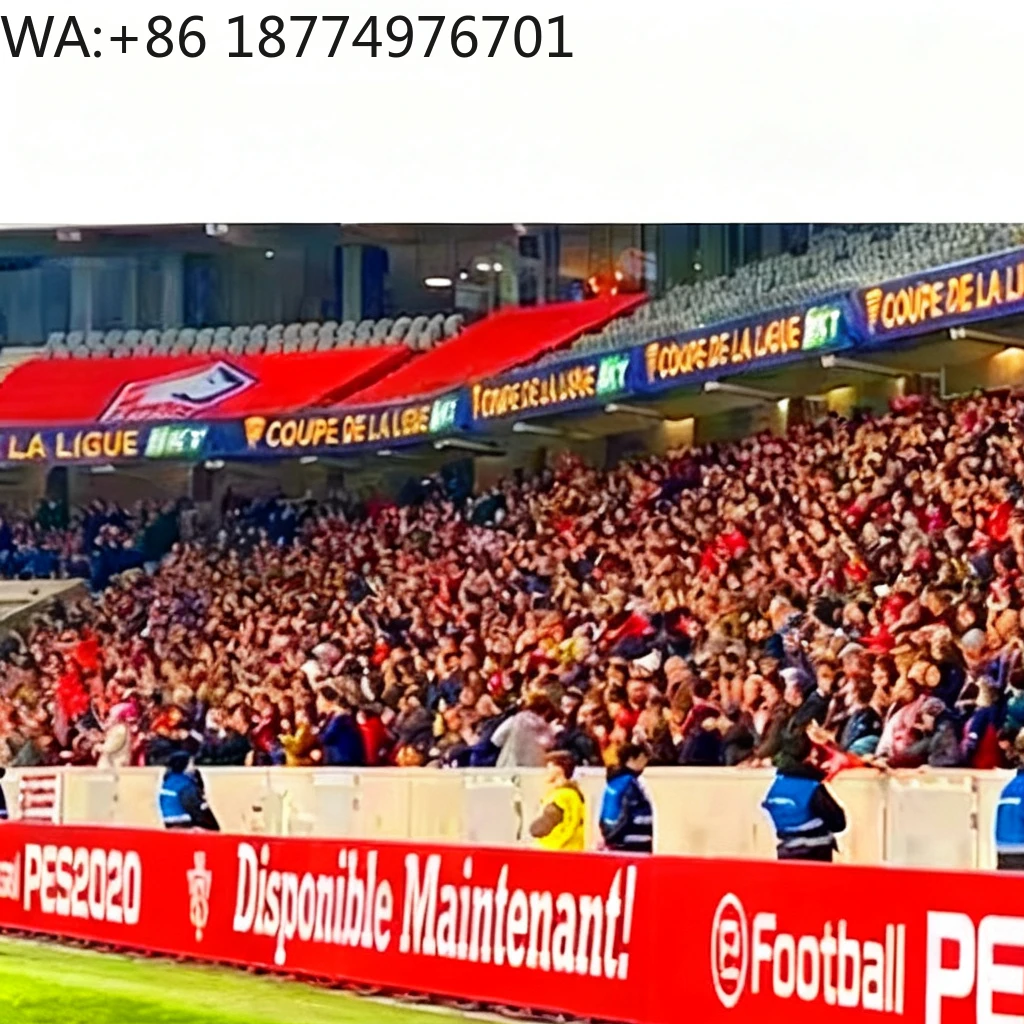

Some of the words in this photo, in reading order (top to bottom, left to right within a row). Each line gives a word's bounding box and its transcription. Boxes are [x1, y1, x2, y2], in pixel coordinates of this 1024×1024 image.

[882, 281, 944, 328] COUPE
[946, 273, 973, 313] DE
[977, 269, 1002, 308] LA
[8, 433, 46, 459] LA
[56, 430, 139, 457] LIGUE
[266, 416, 339, 447] COUPE
[342, 414, 366, 444] DE
[368, 411, 392, 441] LA
[23, 843, 141, 925] PES2020
[233, 842, 393, 965] Disponible
[400, 852, 637, 979] Maintenant!
